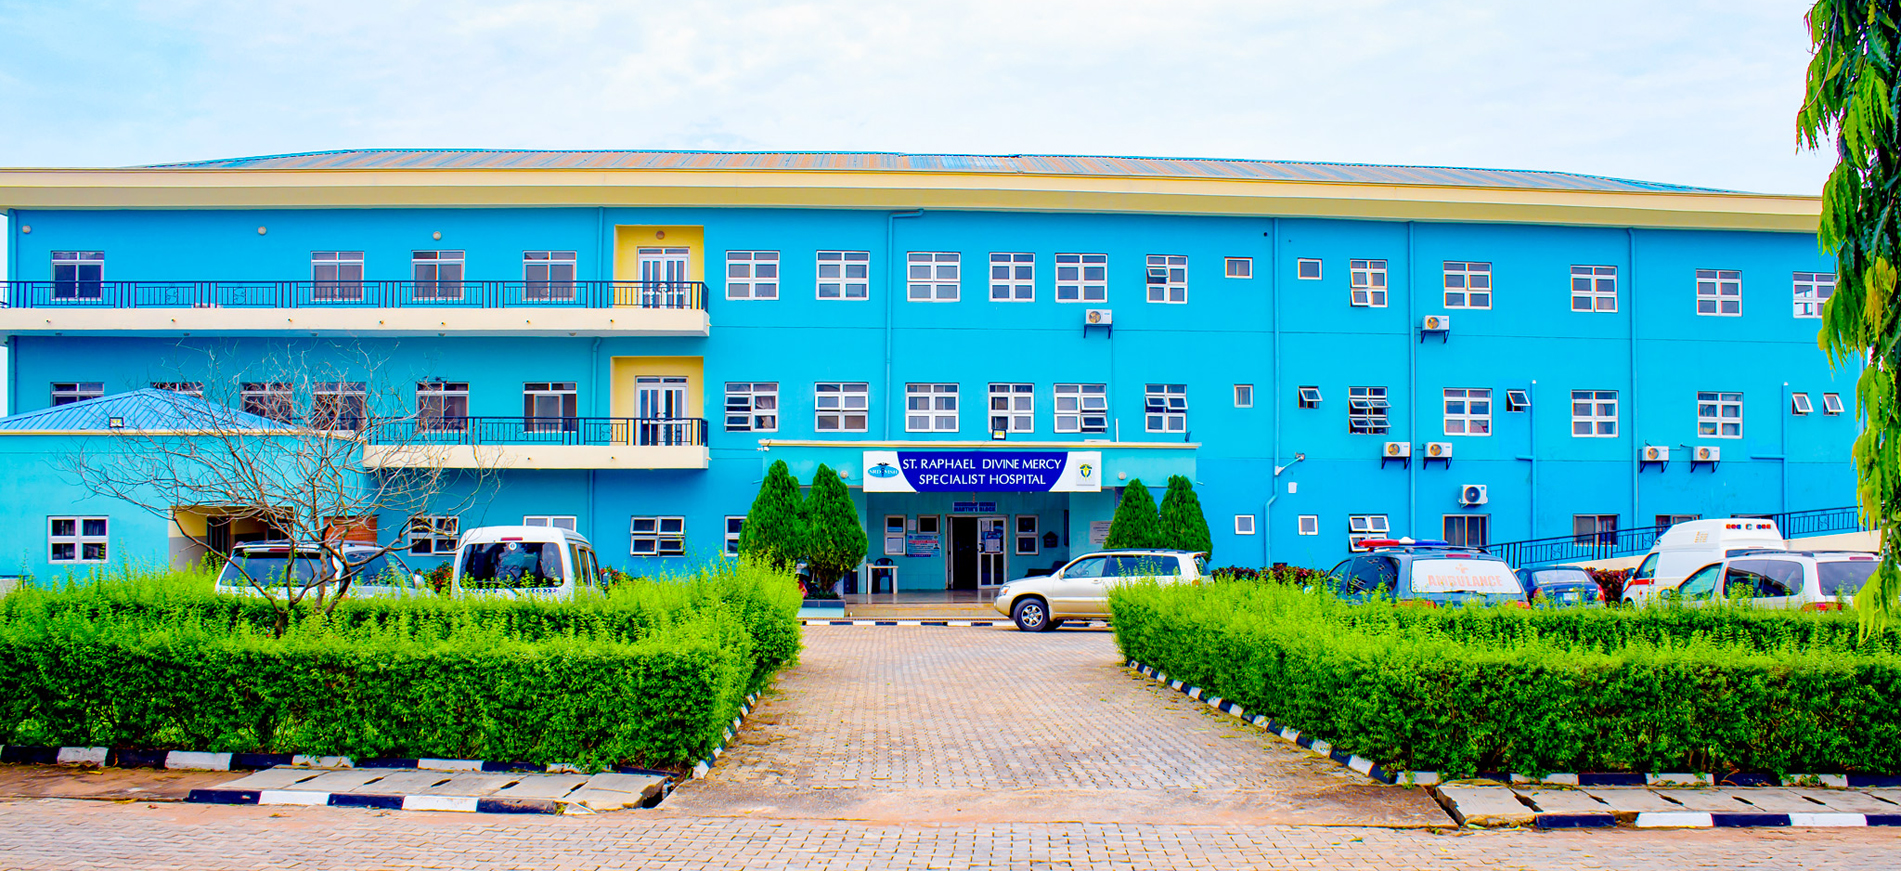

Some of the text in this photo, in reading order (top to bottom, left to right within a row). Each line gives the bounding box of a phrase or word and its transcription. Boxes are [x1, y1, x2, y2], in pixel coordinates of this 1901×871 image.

[902, 458, 1062, 470] ST. RAPHAEL DIVINE MERCY
[918, 473, 1047, 485] SPECIALIST HOSPITAL
[1427, 574, 1503, 587] AMBULANCE
